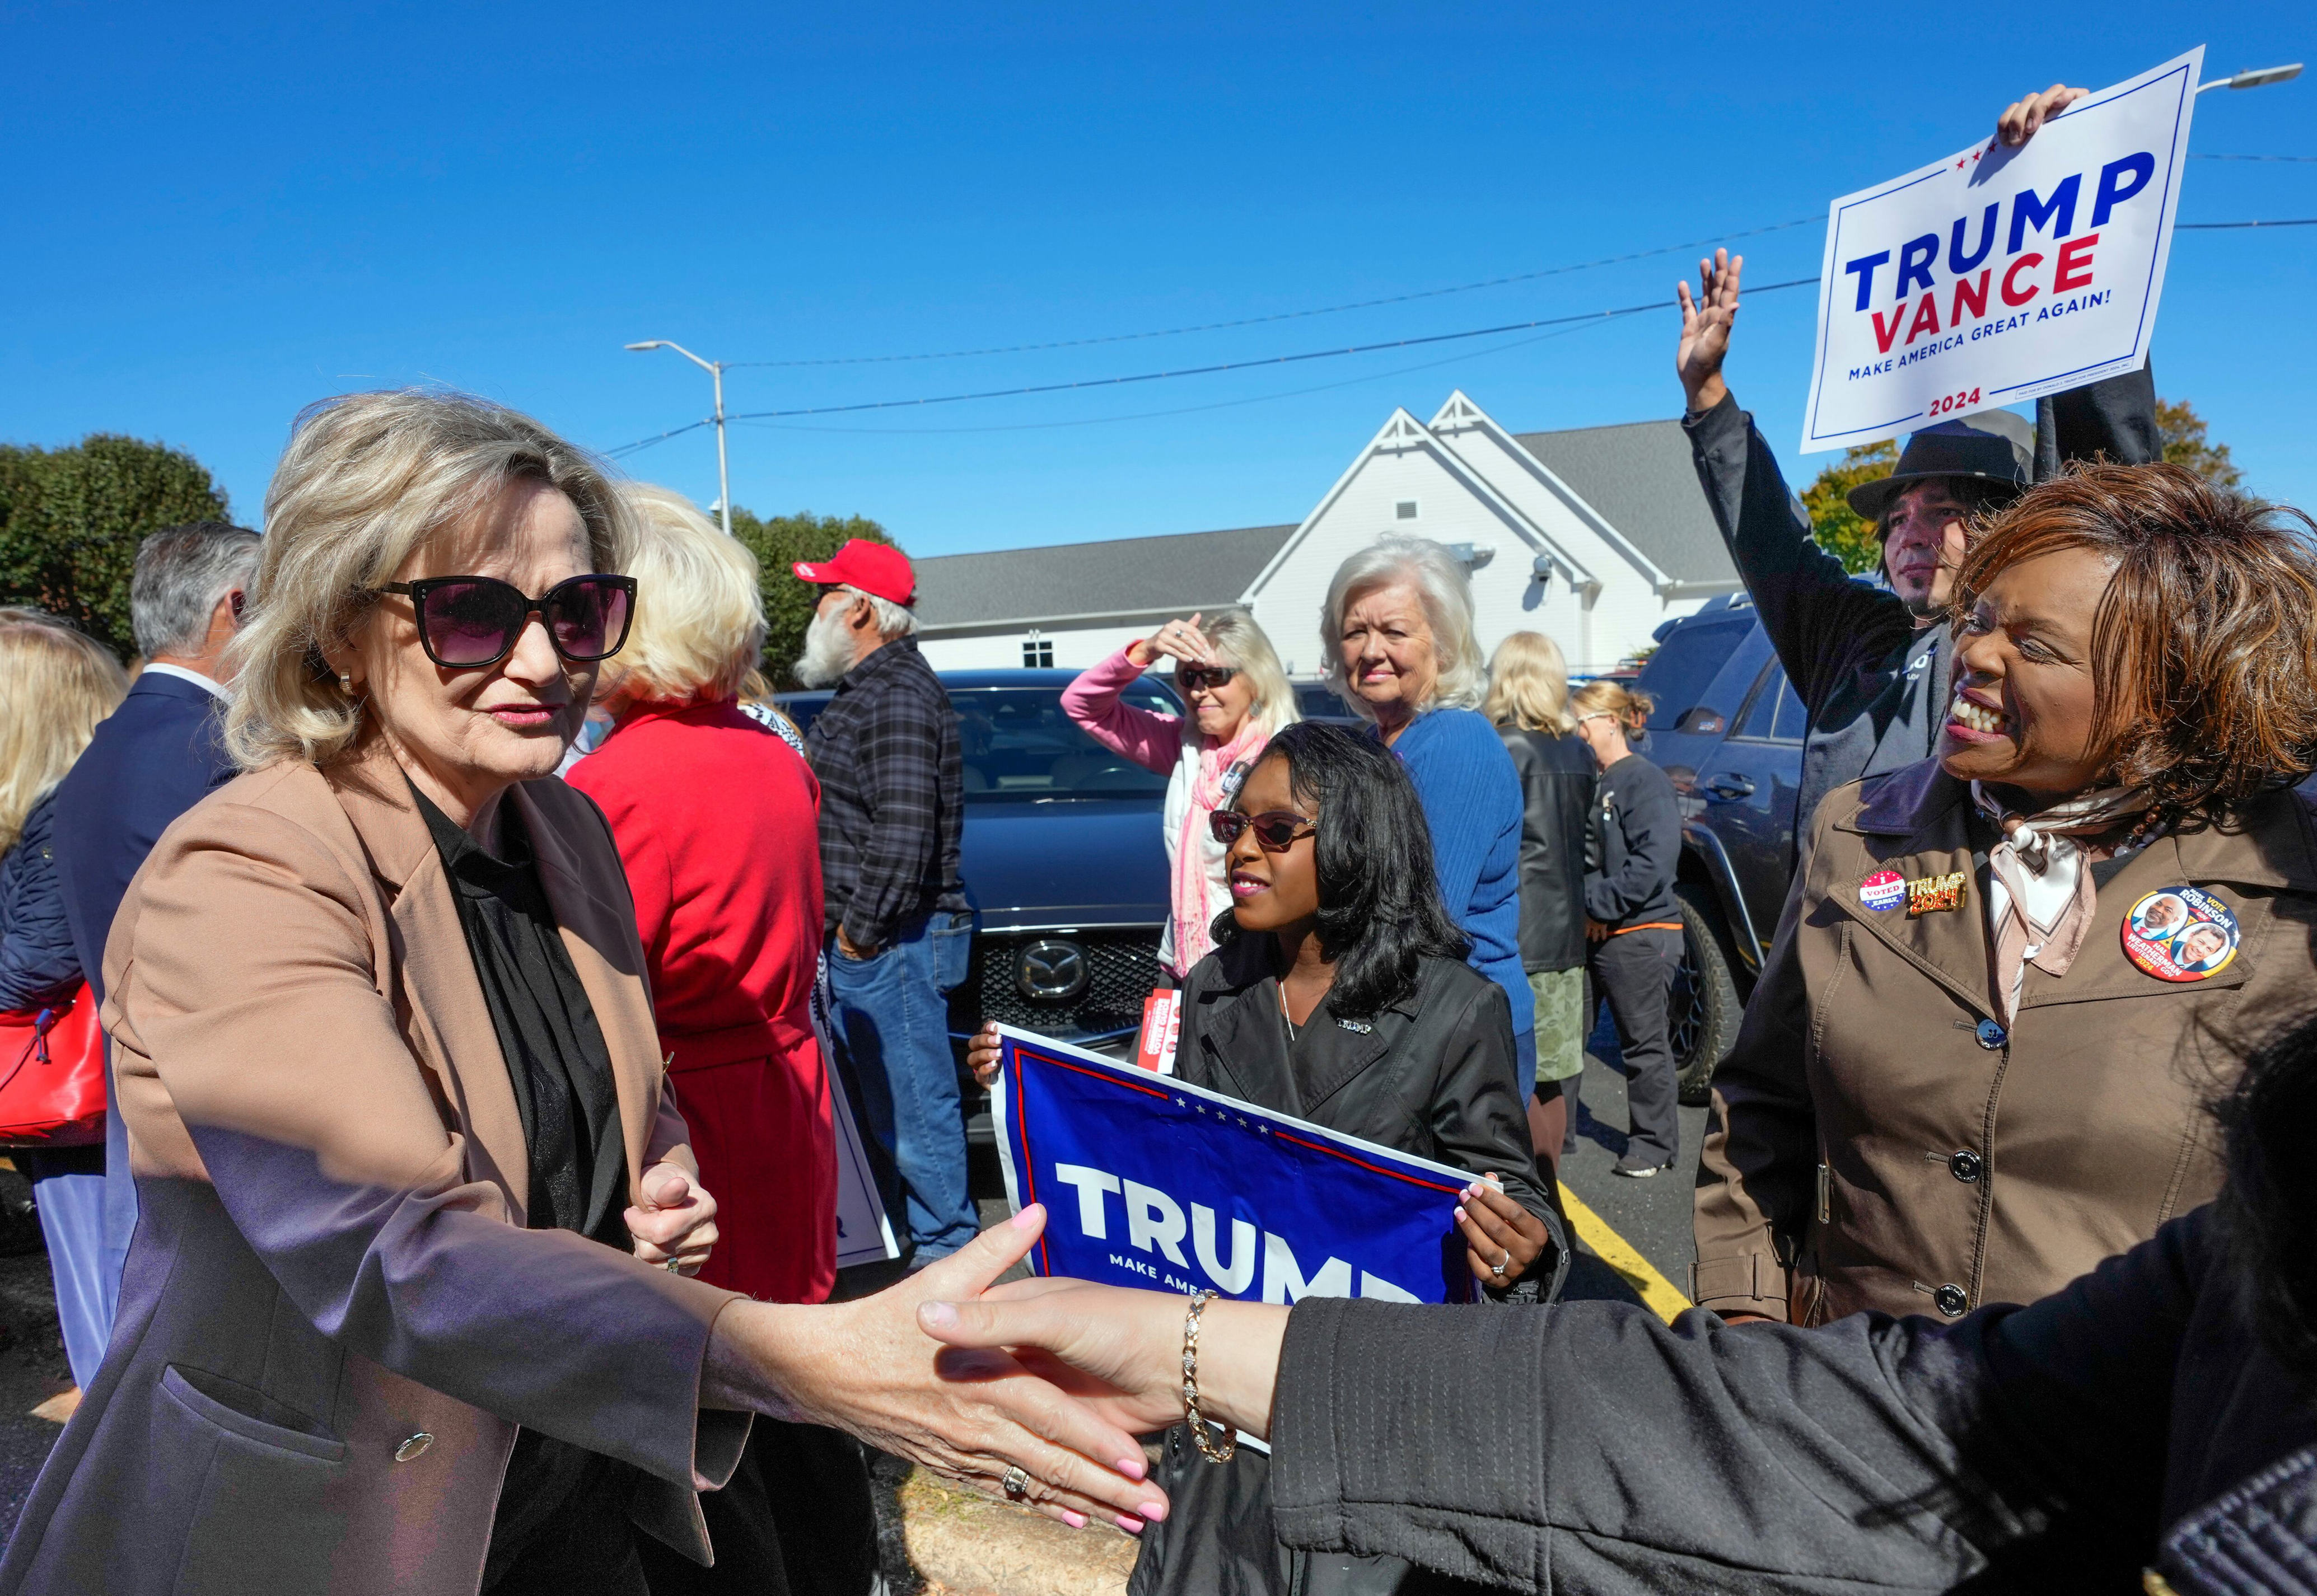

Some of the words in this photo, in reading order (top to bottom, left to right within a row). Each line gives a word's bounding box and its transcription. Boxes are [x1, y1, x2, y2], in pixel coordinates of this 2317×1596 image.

[1845, 152, 2155, 312] TRUMP
[1871, 233, 2100, 354] VANCE
[1848, 359, 1893, 381] MAKE
[1898, 333, 1964, 368] AMERICA
[1971, 312, 2030, 341] GREAT
[2036, 289, 2112, 322] AGAIN!
[2087, 368, 2109, 378] PRESIDENT
[1928, 387, 1981, 418] 2024
[1866, 885, 1900, 897] VOTED
[1880, 876, 1886, 884] I
[1907, 871, 1966, 897] TRUMP
[1872, 896, 1898, 907] EARLY
[1910, 888, 1958, 913] 2024
[2189, 888, 2206, 900] MARK
[2206, 896, 2227, 914] VOTE
[2179, 888, 2233, 929] ROBINSON
[2195, 911, 2209, 921] GOV
[2126, 941, 2162, 968] LIEUTENANT
[2160, 966, 2175, 978] GOV
[2127, 933, 2183, 977] WEATHERMAN
[2152, 942, 2167, 956] HAL
[2135, 956, 2154, 971] 2024
[1337, 1017, 1371, 1035] TRUMP
[1152, 1027, 1165, 1055] VOTER
[1109, 1253, 1157, 1279] MAKE
